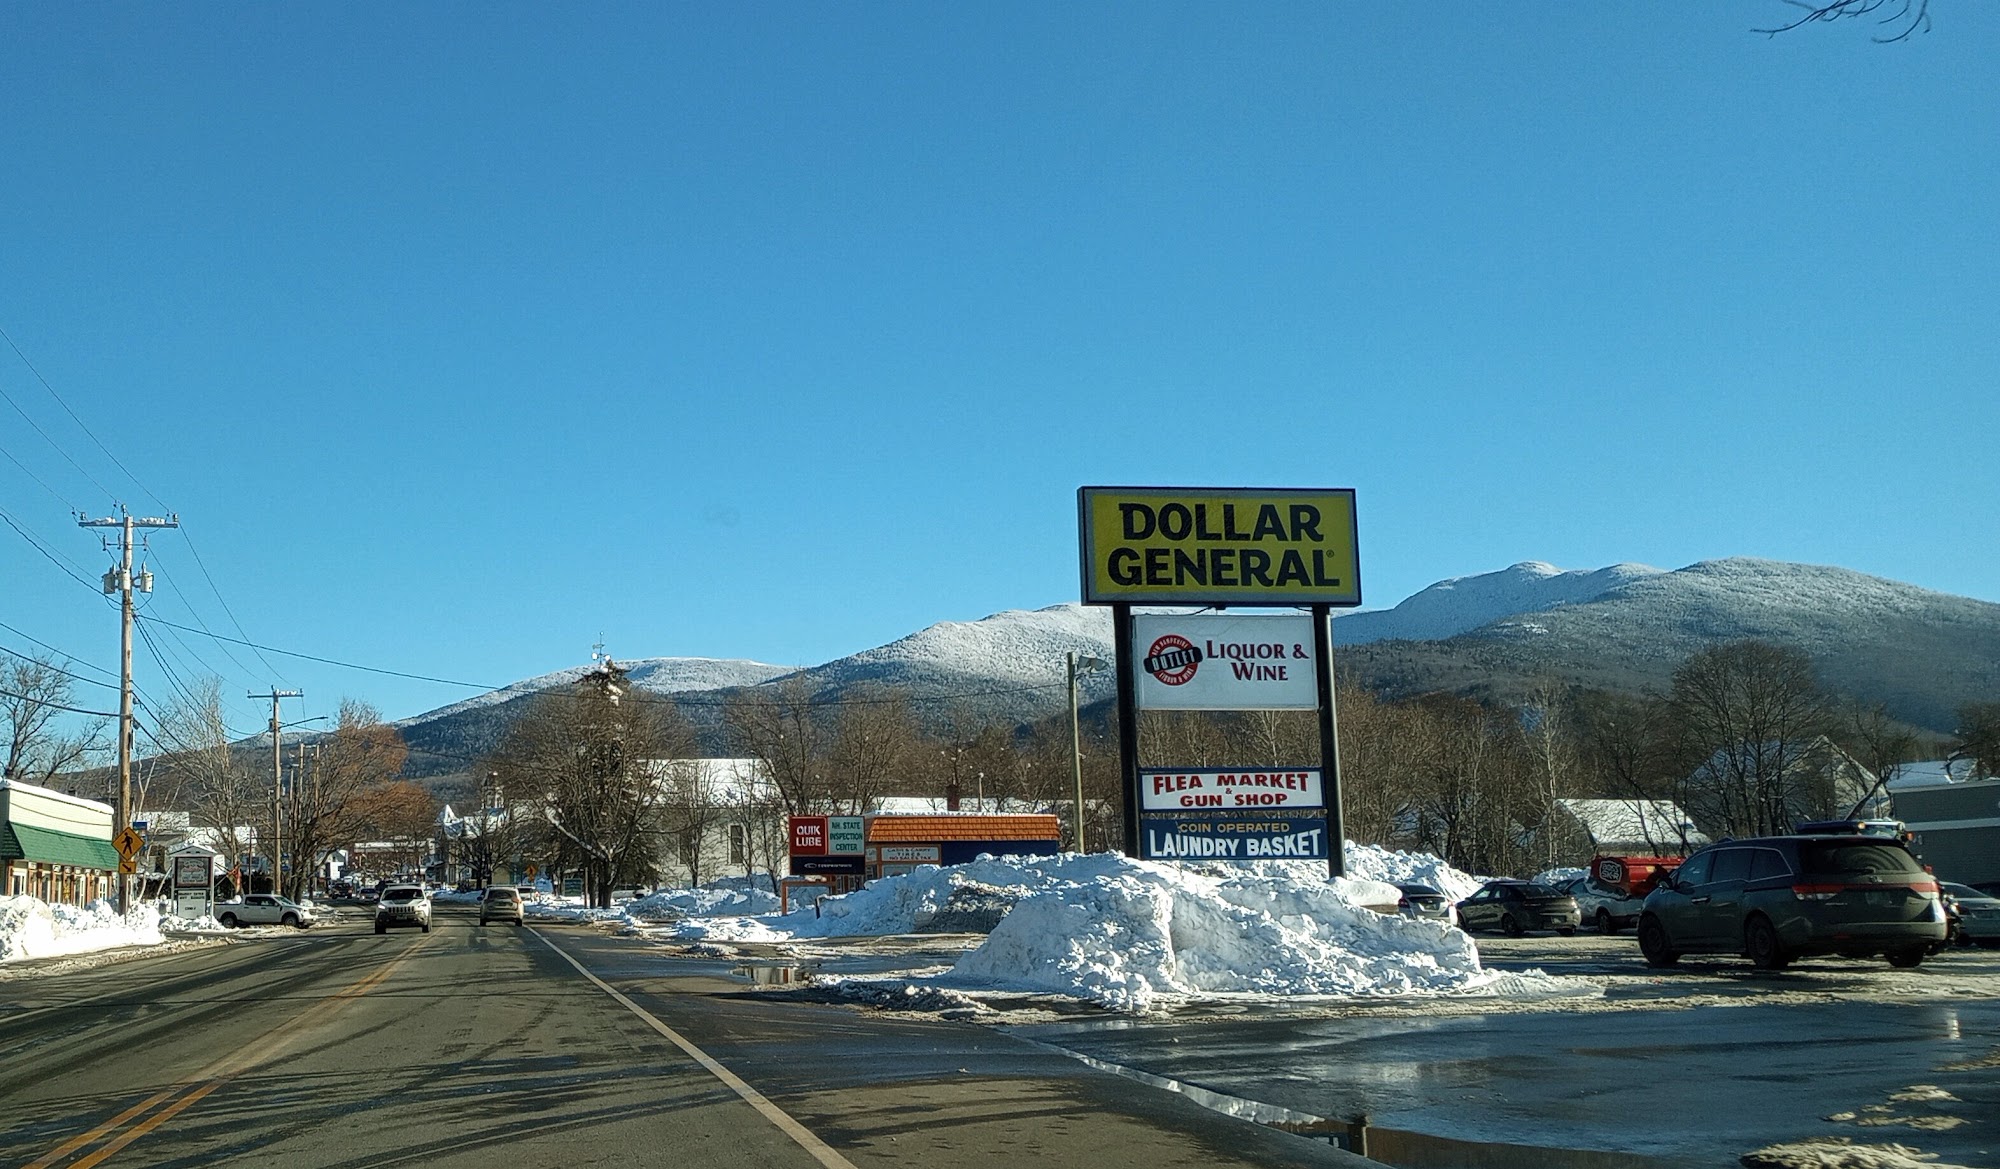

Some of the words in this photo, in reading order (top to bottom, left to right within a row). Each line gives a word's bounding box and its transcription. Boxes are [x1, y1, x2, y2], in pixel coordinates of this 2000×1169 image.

[1118, 502, 1324, 542] DOLLAR
[1206, 639, 1287, 662] LIQUOR
[1292, 643, 1310, 659] &
[1151, 649, 1196, 671] OUTLET
[1230, 662, 1289, 681] WINE
[1153, 775, 1203, 796] FLEA
[1216, 773, 1309, 792] MARKET
[1225, 787, 1233, 795] &
[1180, 795, 1223, 807] GUN
[1235, 793, 1288, 806] SHOP
[796, 825, 821, 836] QUIK
[843, 821, 861, 830] STATE
[1178, 823, 1211, 833] COIN
[1217, 822, 1290, 833] OPERATED
[795, 836, 822, 847] LUBE
[830, 832, 863, 841] INSPECTION
[1149, 828, 1240, 857] LAUNDRY
[1246, 828, 1321, 857] BASKET
[835, 843, 858, 851] CENTER
